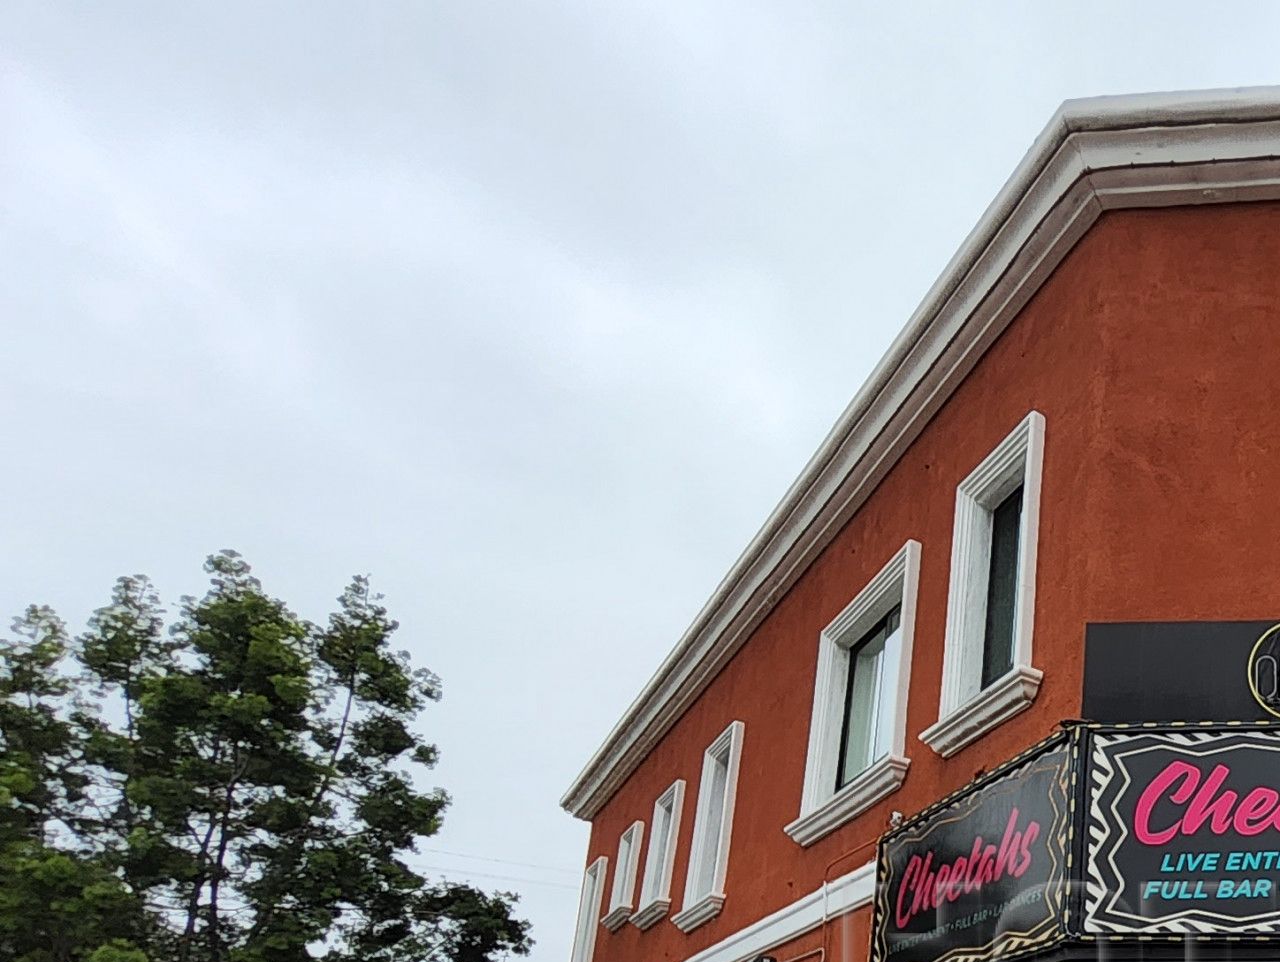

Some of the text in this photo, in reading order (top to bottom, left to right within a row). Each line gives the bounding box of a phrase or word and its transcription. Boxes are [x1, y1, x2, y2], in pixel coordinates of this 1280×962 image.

[896, 806, 1041, 929] Cheetahs
[1160, 852, 1219, 873] LIVE
[1142, 879, 1211, 900] FULL
[1215, 878, 1272, 899] BAR
[972, 908, 988, 925] BAR
